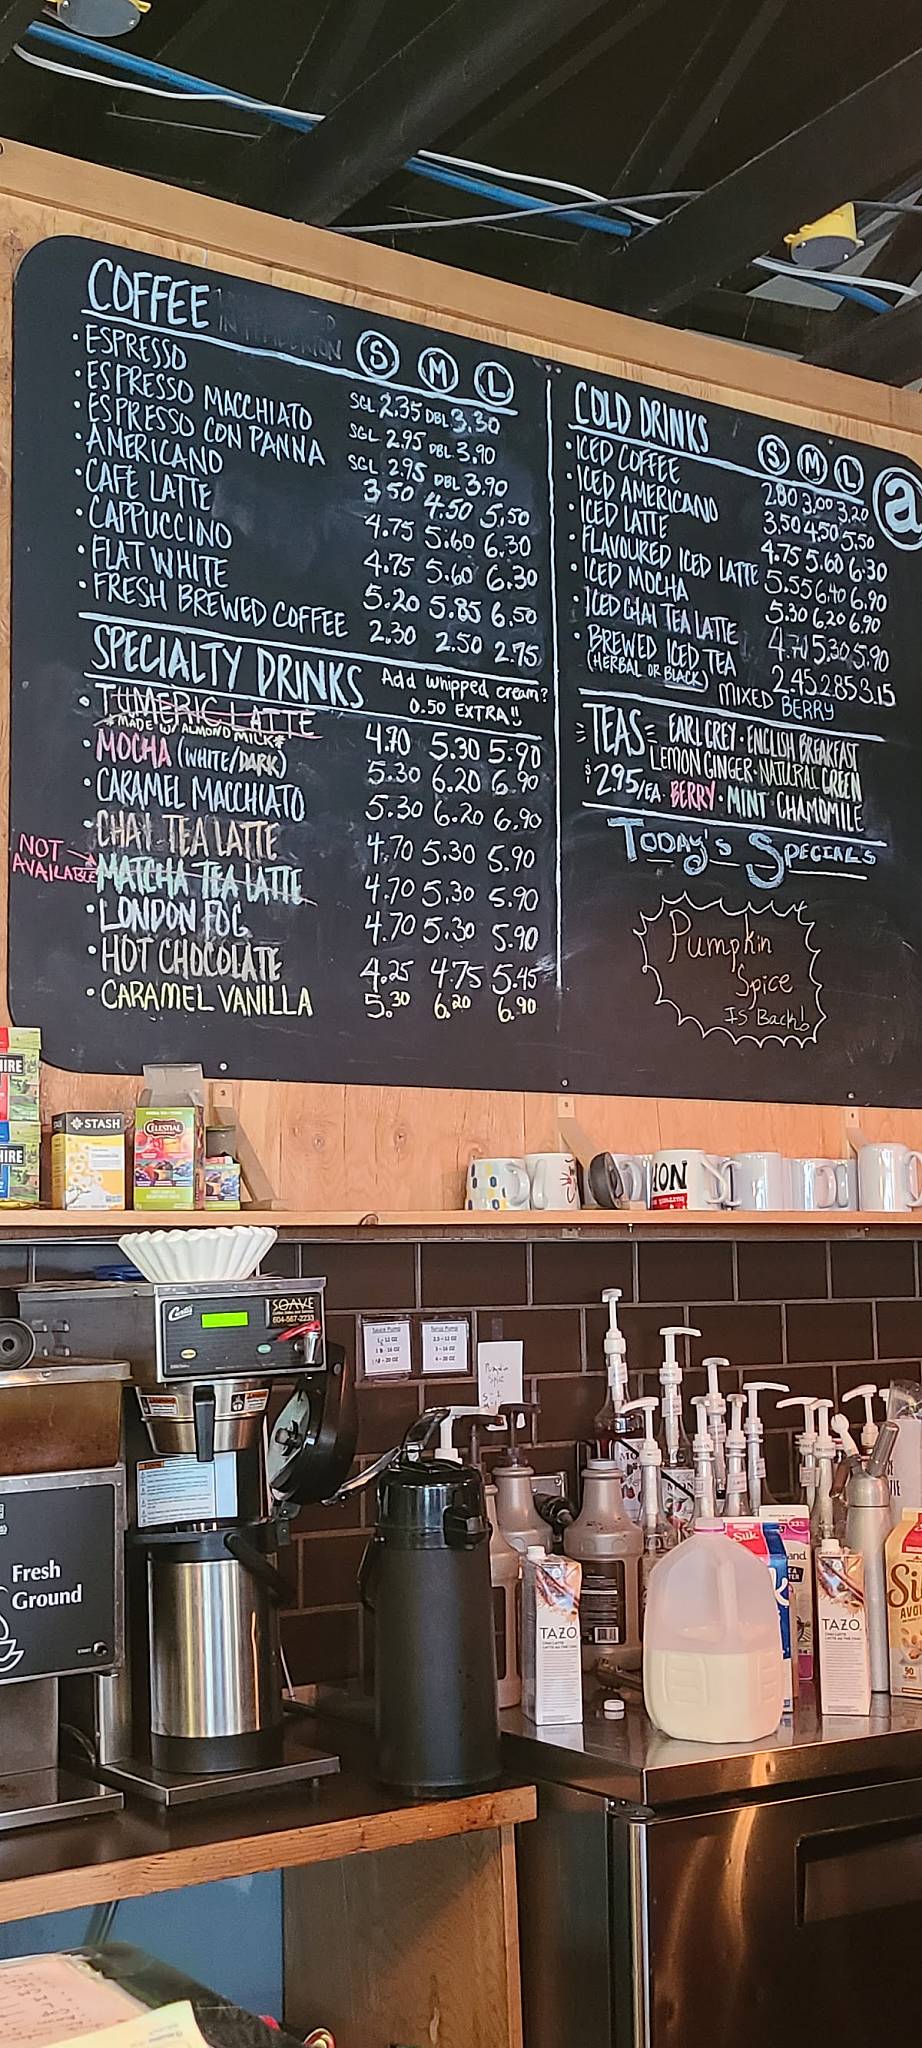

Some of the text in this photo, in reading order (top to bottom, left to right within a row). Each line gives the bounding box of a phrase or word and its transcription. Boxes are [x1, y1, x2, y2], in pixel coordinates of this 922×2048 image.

[88, 259, 209, 328] COFFEE
[86, 324, 186, 370] ESPRESSO
[370, 340, 388, 369] S
[429, 356, 447, 387] M
[488, 370, 506, 398] L
[87, 361, 312, 430] ESPRESSO MACCHIATO
[575, 381, 709, 454] COLD DRINKS
[86, 423, 223, 475] AMERICANO
[88, 393, 326, 467] ESPRESSO CON PANNA
[577, 435, 680, 484] ICED COFFEE
[766, 441, 856, 488] S M L
[150, 470, 212, 511] LATTE
[577, 464, 719, 523] ICED AMERICANO
[89, 495, 232, 549] CAPPUCCINO
[365, 514, 414, 541] 4.75
[580, 496, 669, 539] ICED LATTE
[92, 535, 228, 588] FLAT WHITE
[364, 549, 414, 577] 4.75
[582, 525, 760, 588] FLAVOURED ICED LATTE
[761, 539, 844, 574] 4.75 5.60
[363, 584, 420, 612] 5.20
[584, 556, 688, 602] ICED MOCHA
[764, 569, 813, 599] 5.55
[94, 572, 348, 637] FRESH BREWED COFFEE
[585, 586, 739, 645] ICED CHAI TEA LATTE
[765, 599, 880, 634] 5.30 6.90
[369, 620, 539, 667] 2.30 2.50 2.75
[588, 625, 737, 677] BREWED ICED TEA
[92, 624, 362, 709] SPECIALTY DRINKS
[382, 667, 416, 689] Add
[496, 686, 548, 703] cream?
[587, 650, 709, 692] (HERBAL OR BLACK)
[771, 665, 817, 696] 2.45
[410, 698, 446, 715] 0.50
[719, 682, 834, 721] MIXED BERRY
[96, 728, 286, 779] MOCHA (WHITE/DARK)
[429, 732, 480, 760] 5.30
[583, 703, 860, 772] TEAS EARL GREY ENGLISH BREAKFAST
[96, 767, 305, 822] CARAMEL MACCHIATO
[650, 745, 862, 800] LEMON GINGER NATURAL GREEN
[365, 795, 542, 831] 5.30 6.90
[670, 780, 715, 811] BERRY
[727, 787, 767, 819] MINT
[776, 792, 864, 832] CHAMOMILE
[20, 834, 64, 861] NOT
[96, 810, 280, 862] CHAI TEA LATTE
[12, 853, 97, 883] AVAILABLE
[97, 852, 303, 904] MATCHA TEA LATTE
[487, 845, 535, 872] 5.90
[100, 897, 250, 938] LONDON FOG
[488, 887, 538, 911] 5.90
[102, 936, 282, 983] HOT CHOCOLATE
[668, 910, 772, 972] Pumpkin
[360, 958, 414, 993] 4.25
[736, 963, 793, 1010] Spice
[101, 980, 313, 1016] CARAMEL VANILLA
[757, 1006, 809, 1031] Back!
[85, 1118, 120, 1129] STASH
[272, 1297, 315, 1312] SOAVE
[12, 1559, 61, 1583] Fresh
[12, 1584, 82, 1610] Ground
[539, 1626, 577, 1639] TAZO
[821, 1618, 862, 1631] TAZO
